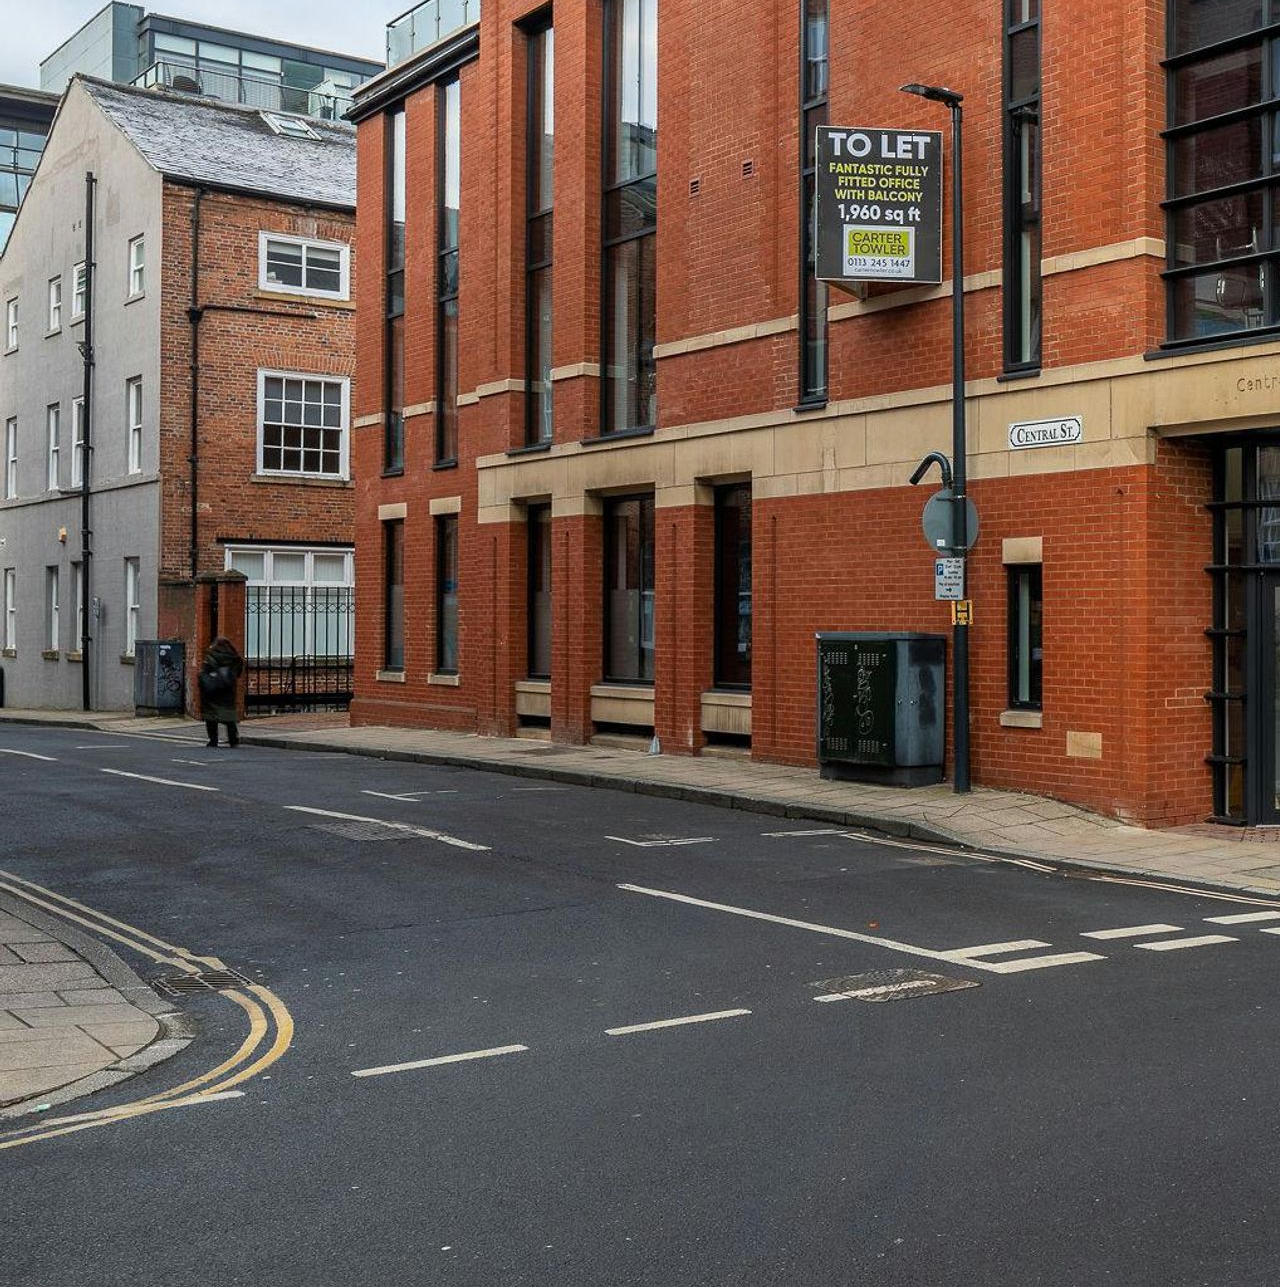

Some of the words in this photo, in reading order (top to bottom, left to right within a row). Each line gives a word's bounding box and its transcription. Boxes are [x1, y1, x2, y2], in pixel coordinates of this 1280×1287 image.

[828, 132, 872, 157] TO
[881, 134, 931, 159] LET
[829, 162, 893, 175] FANTASTIC
[895, 165, 929, 177] FULLY
[838, 176, 876, 187] FITTED
[879, 177, 920, 189] OFFICE
[835, 189, 865, 200] WITH
[868, 190, 923, 202] BALCONY
[838, 203, 880, 222] 1,960
[884, 208, 904, 225] sq
[907, 206, 920, 221] ft
[852, 232, 902, 243] CARTER
[853, 243, 905, 255] TOWLER
[848, 257, 867, 266] 0113
[871, 258, 887, 267] 245
[890, 258, 910, 267] 1447
[1017, 427, 1059, 443] CENTRAL
